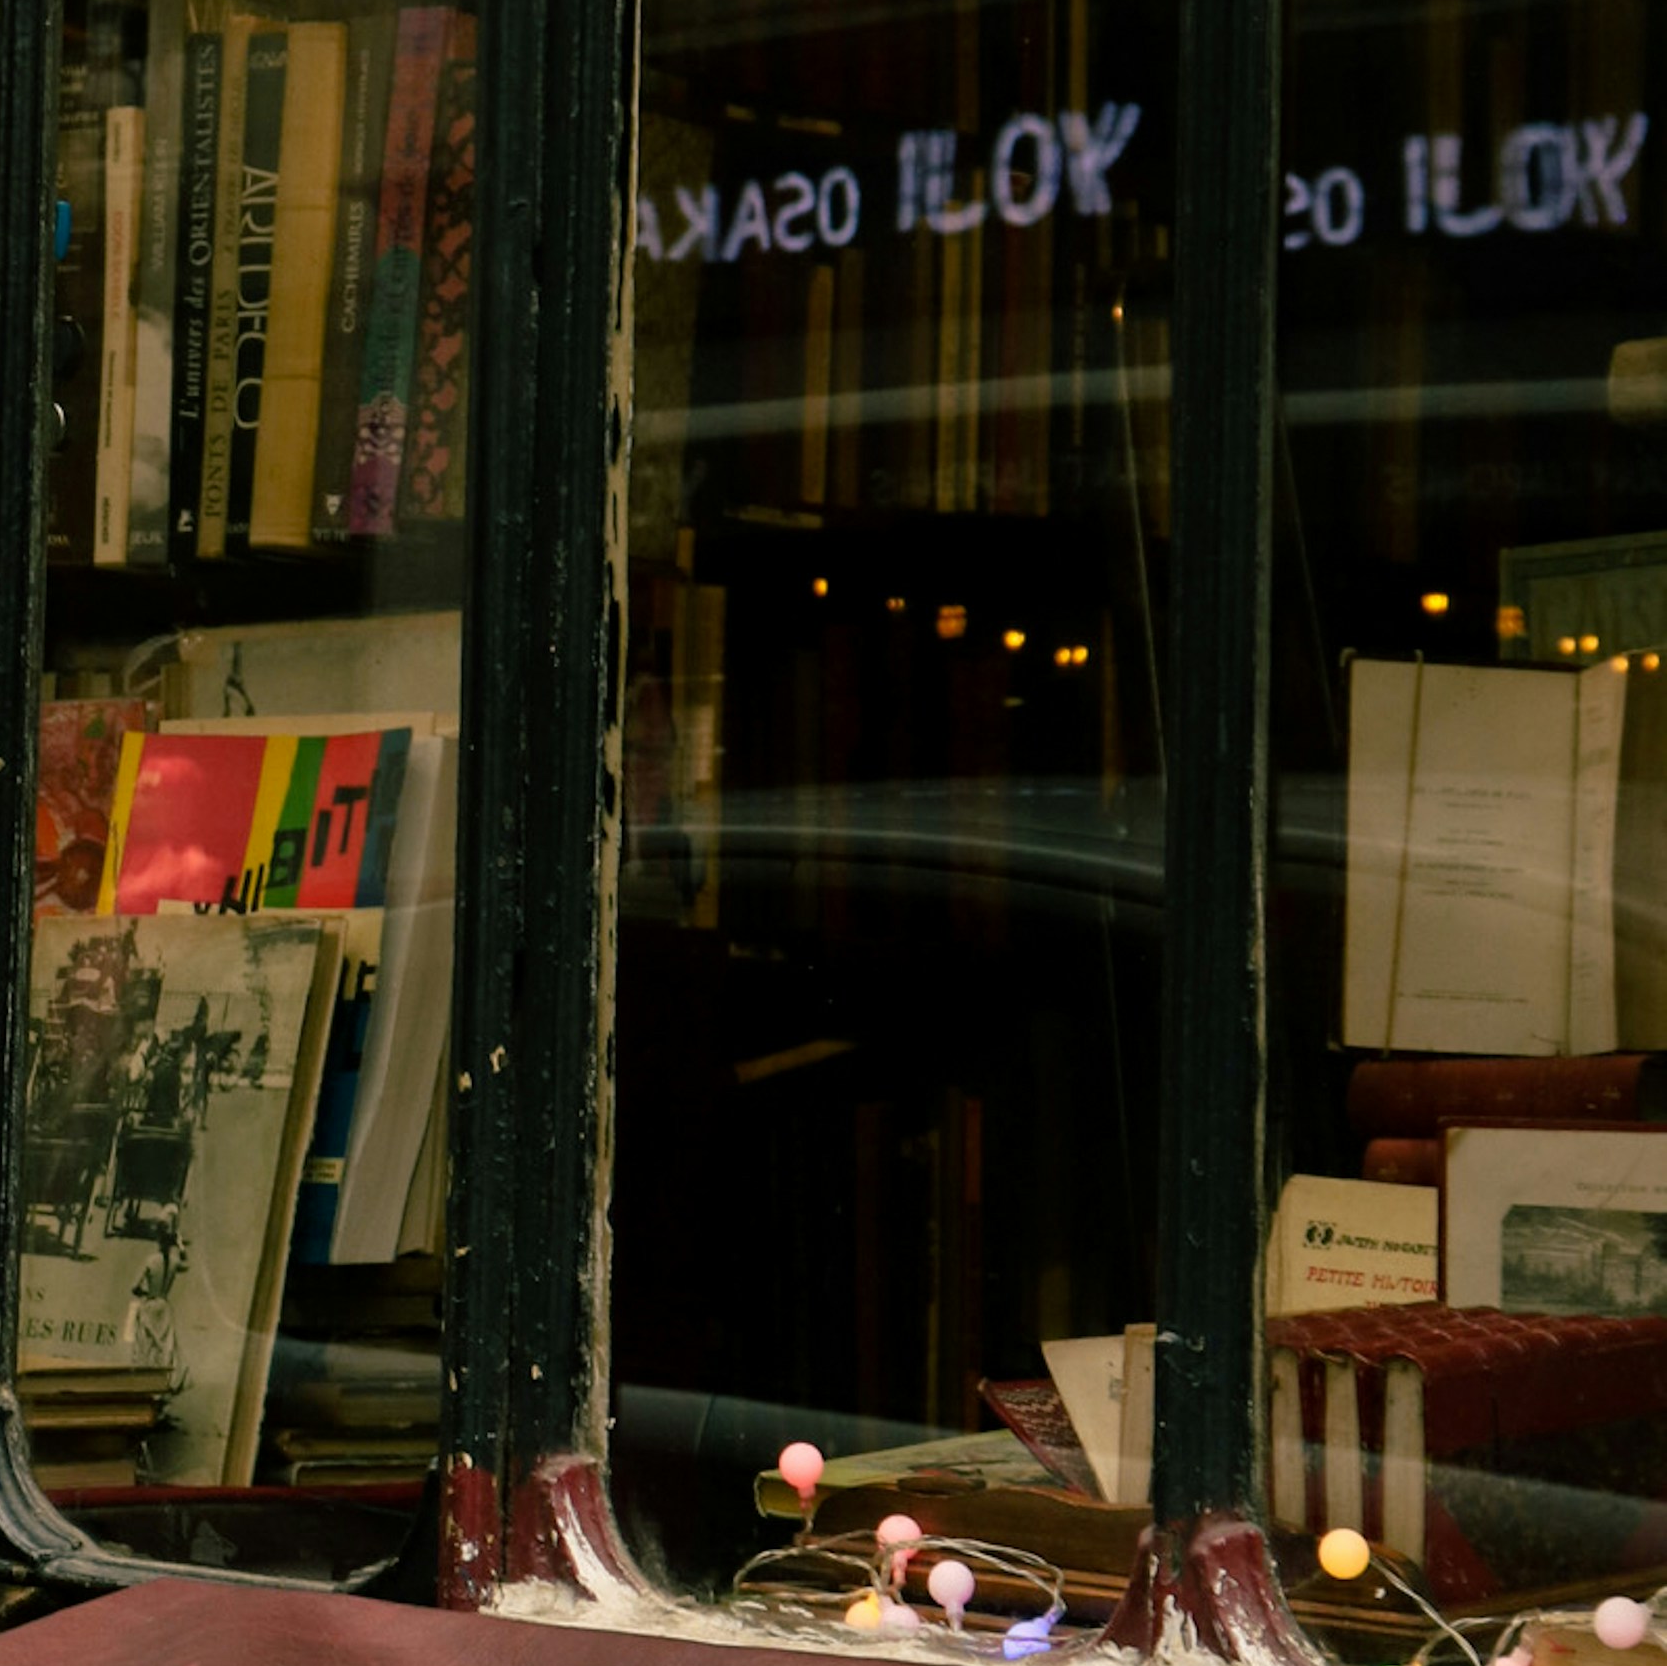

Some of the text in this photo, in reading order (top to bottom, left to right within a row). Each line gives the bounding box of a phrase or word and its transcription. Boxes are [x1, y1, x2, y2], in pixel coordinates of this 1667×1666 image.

[186, 43, 217, 267] ORIENTALISTES
[184, 277, 205, 307] des
[340, 199, 366, 334] CACHEMIRES
[206, 287, 234, 520] PONTS DE PARIS
[1307, 1266, 1365, 1288] PETITE
[62, 1320, 119, 1345] RUES
